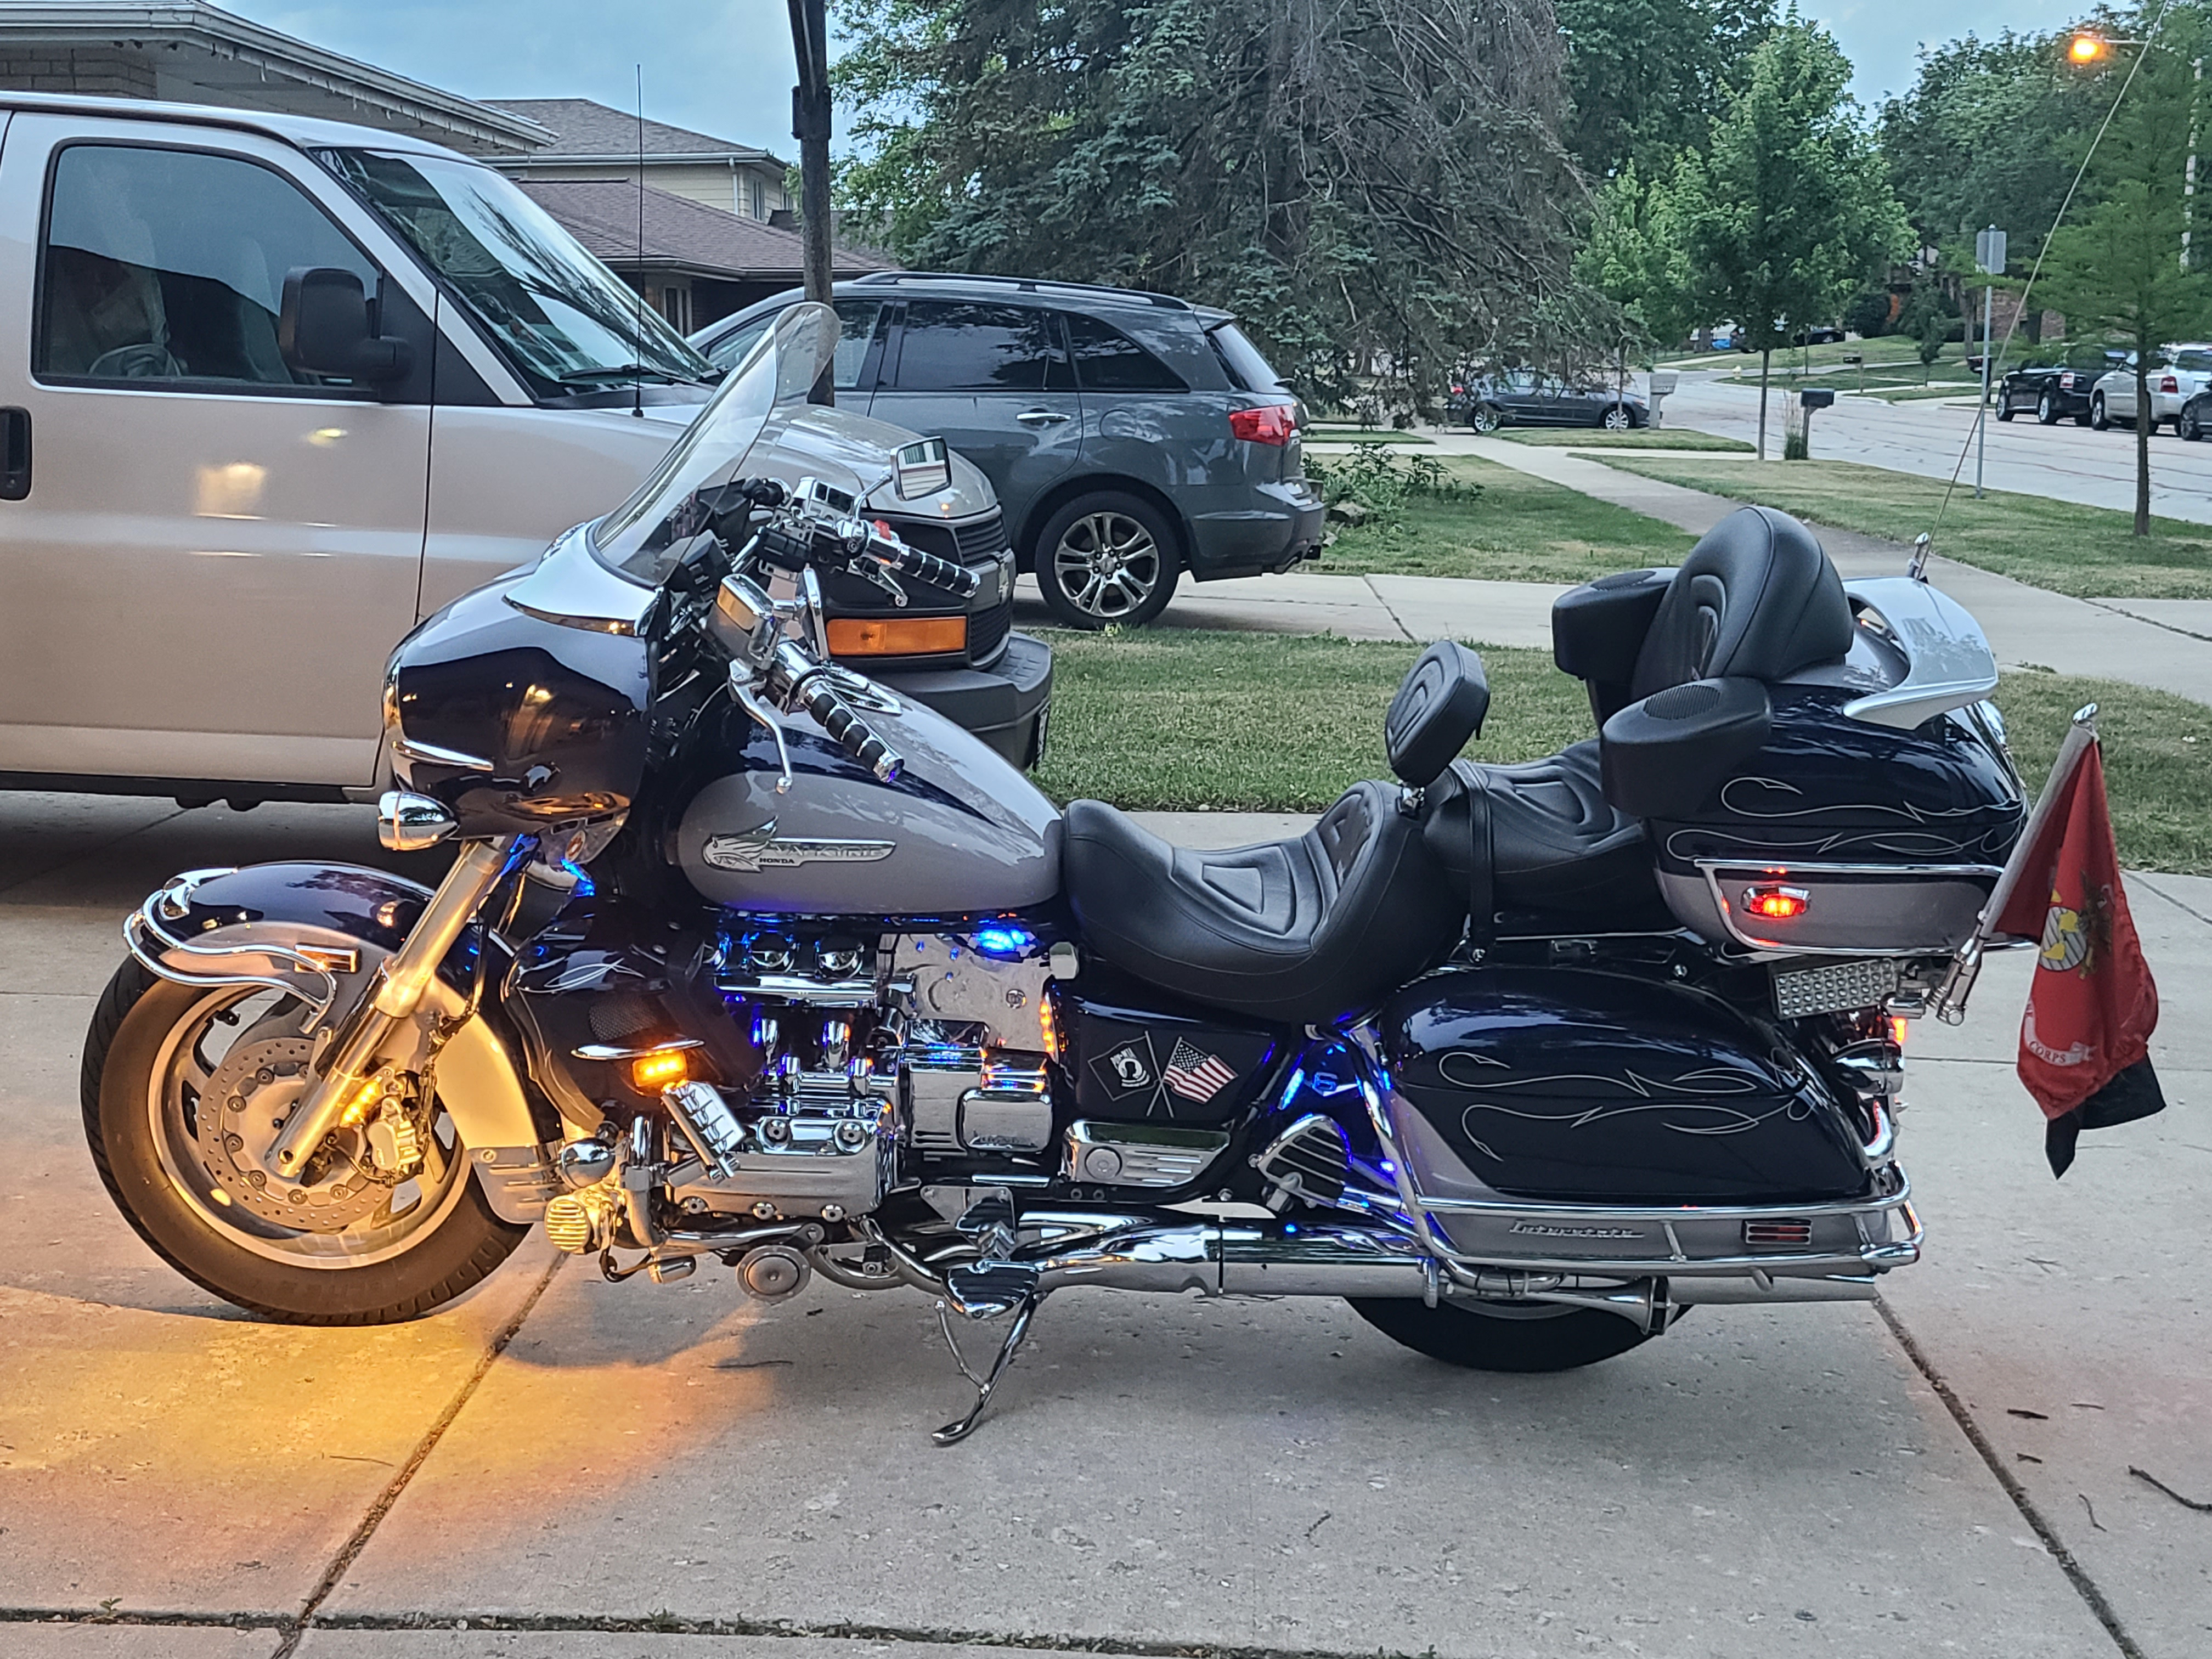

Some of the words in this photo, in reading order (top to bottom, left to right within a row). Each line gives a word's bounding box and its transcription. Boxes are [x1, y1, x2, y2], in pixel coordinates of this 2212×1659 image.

[769, 843, 884, 857] VALKYRIE
[2029, 1041, 2066, 1063] CORPS
[1509, 1219, 1645, 1239] Interstate
